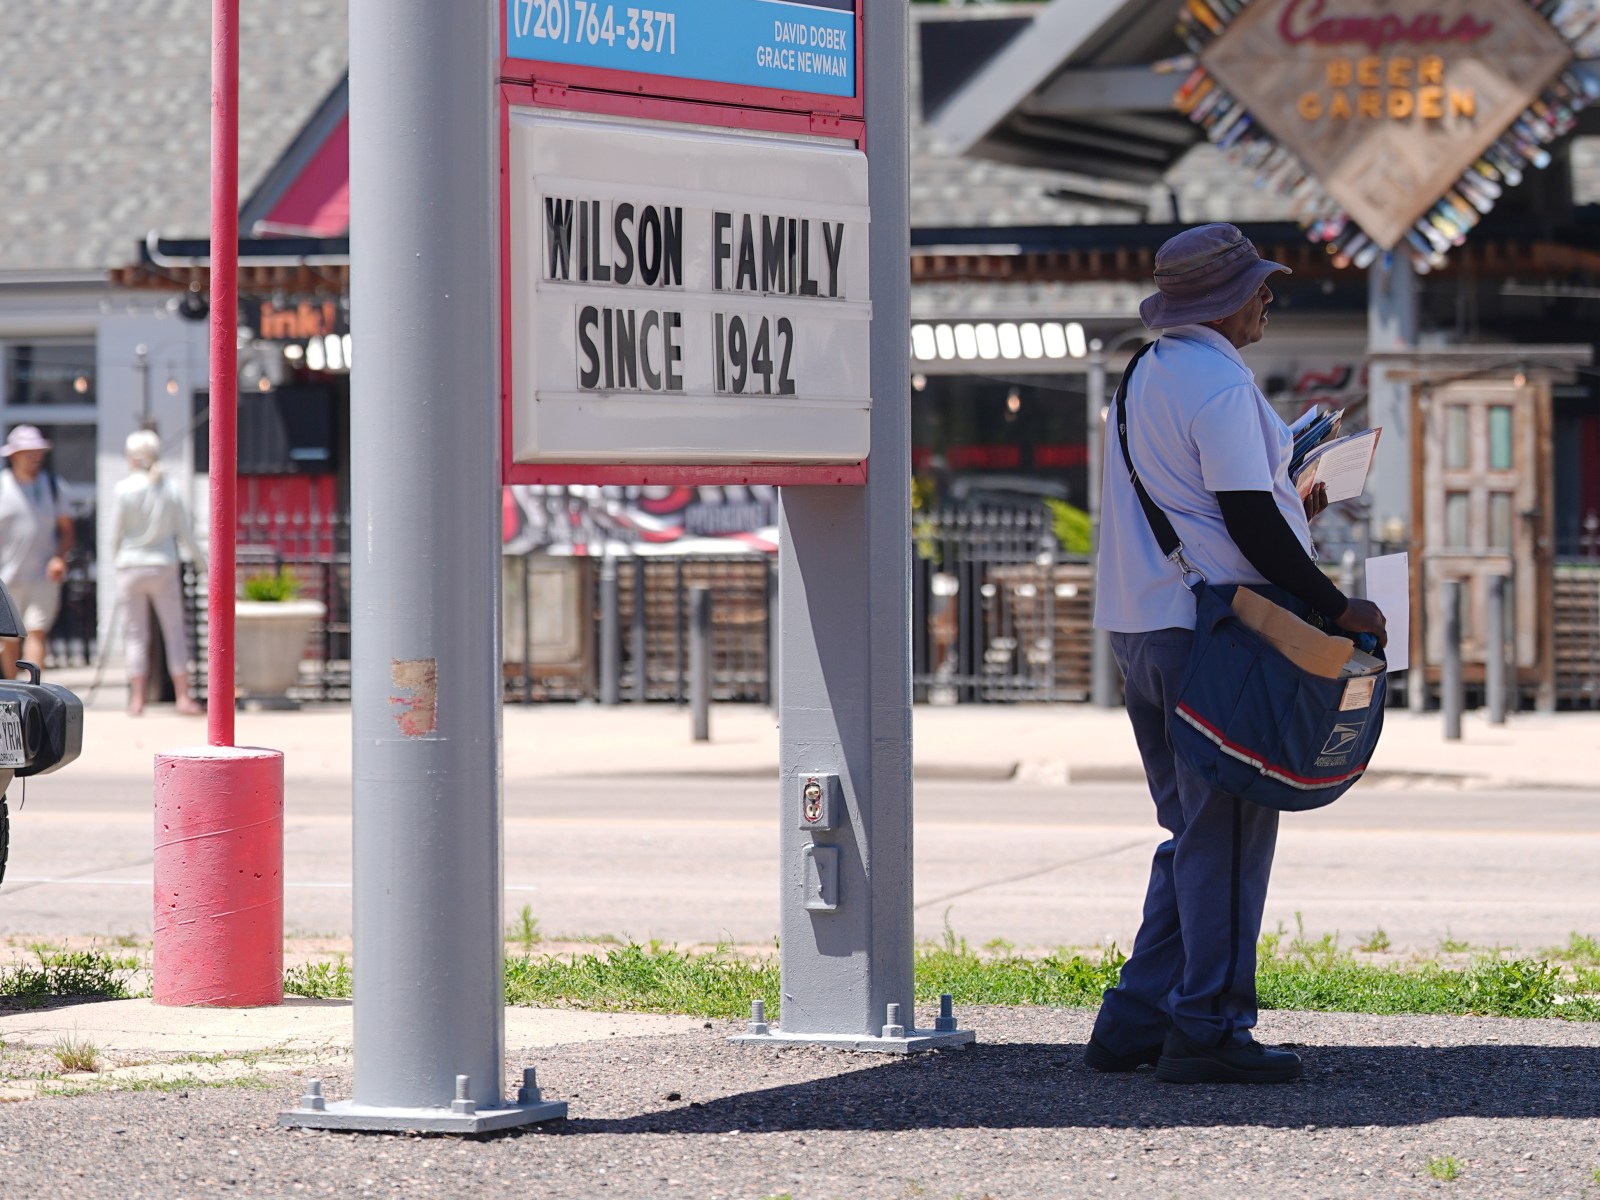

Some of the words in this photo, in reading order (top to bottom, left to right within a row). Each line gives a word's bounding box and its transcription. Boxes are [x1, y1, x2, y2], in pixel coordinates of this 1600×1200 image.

[575, 0, 675, 55] 764-3371
[774, 20, 807, 45] DAVID
[810, 25, 847, 51] DOBEK
[756, 46, 795, 71] GRACE
[797, 50, 847, 77] NEWMAN
[1328, 57, 1443, 87] BEER
[1298, 86, 1475, 120] GARDEN
[544, 196, 683, 286] WILSON
[713, 211, 845, 298] FAMILY
[578, 305, 683, 391] SINCE
[714, 312, 796, 395] 1942
